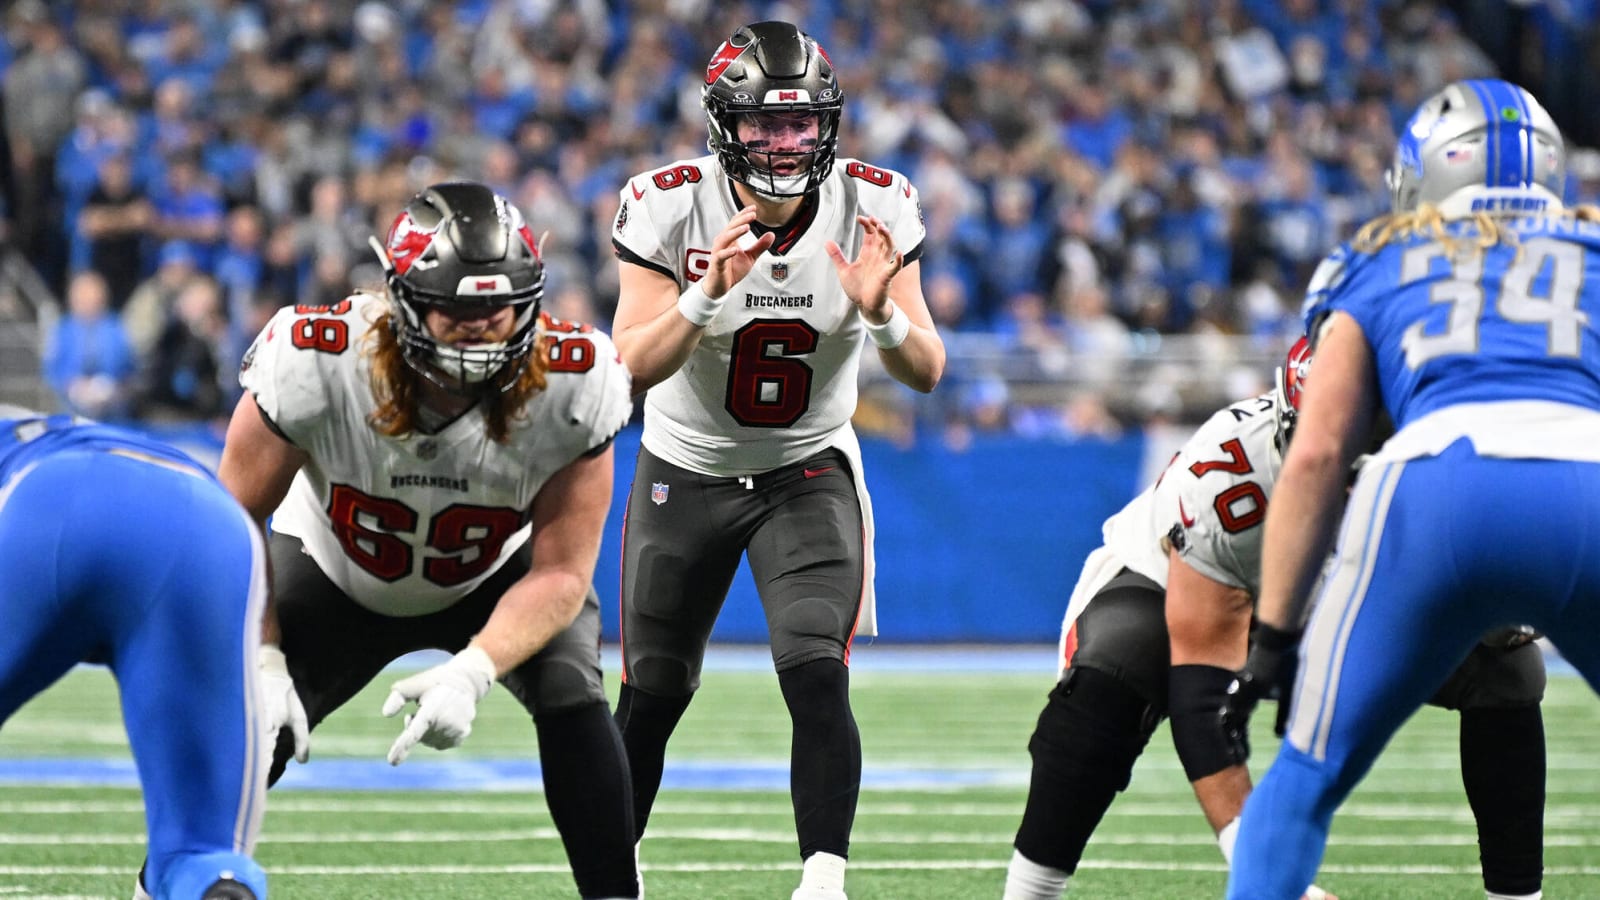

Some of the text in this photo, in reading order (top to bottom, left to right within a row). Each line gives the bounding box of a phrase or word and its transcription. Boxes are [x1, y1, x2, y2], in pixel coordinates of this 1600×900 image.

[652, 165, 702, 191] 6
[1399, 236, 1590, 372] 34
[725, 317, 820, 428] 6
[327, 482, 524, 588] 69
[1188, 437, 1269, 536] 70
